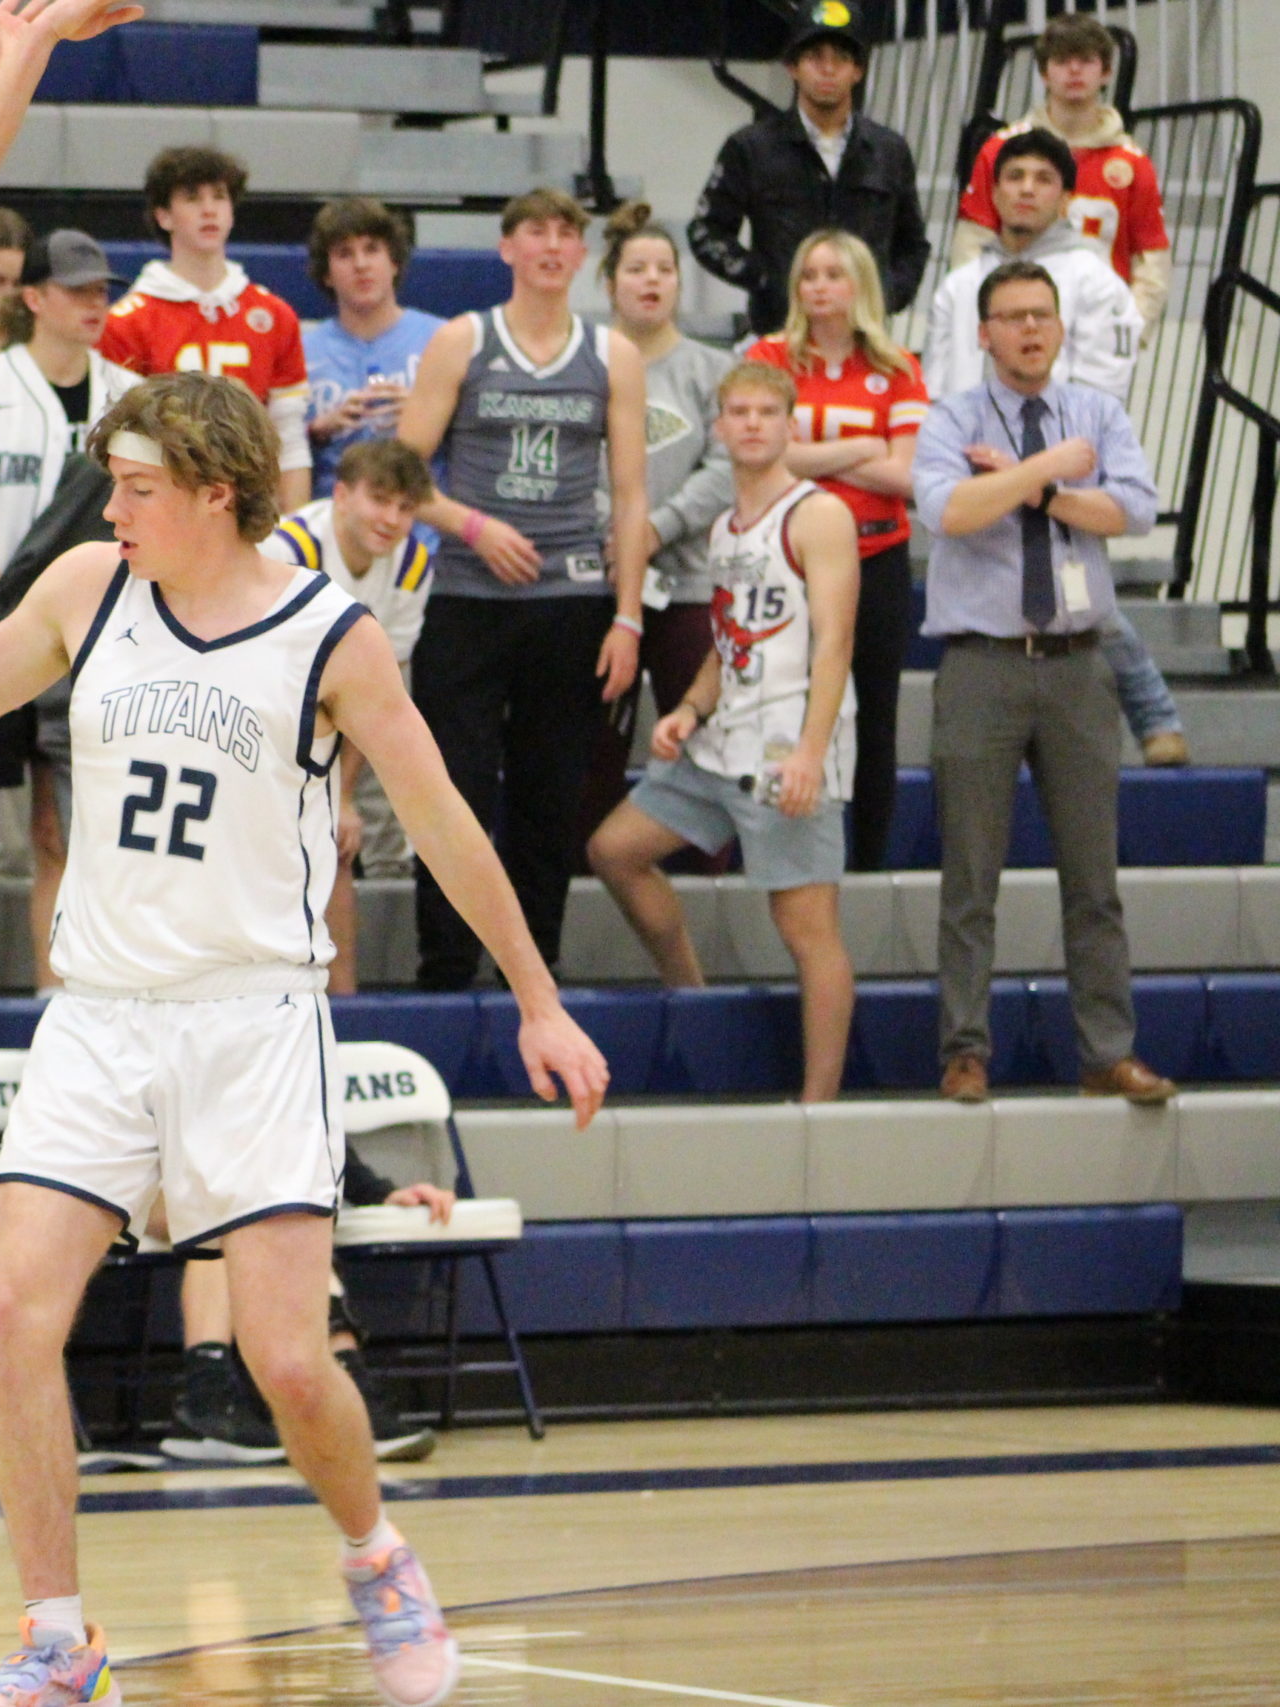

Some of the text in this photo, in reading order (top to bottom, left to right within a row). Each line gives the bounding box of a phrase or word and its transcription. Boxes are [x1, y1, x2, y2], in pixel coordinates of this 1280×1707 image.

[478, 392, 594, 424] KANSAS
[508, 424, 559, 476] 14
[747, 586, 787, 622] 15
[100, 680, 264, 774] TITANS
[118, 758, 218, 861] 22
[344, 1071, 416, 1103] ANS
